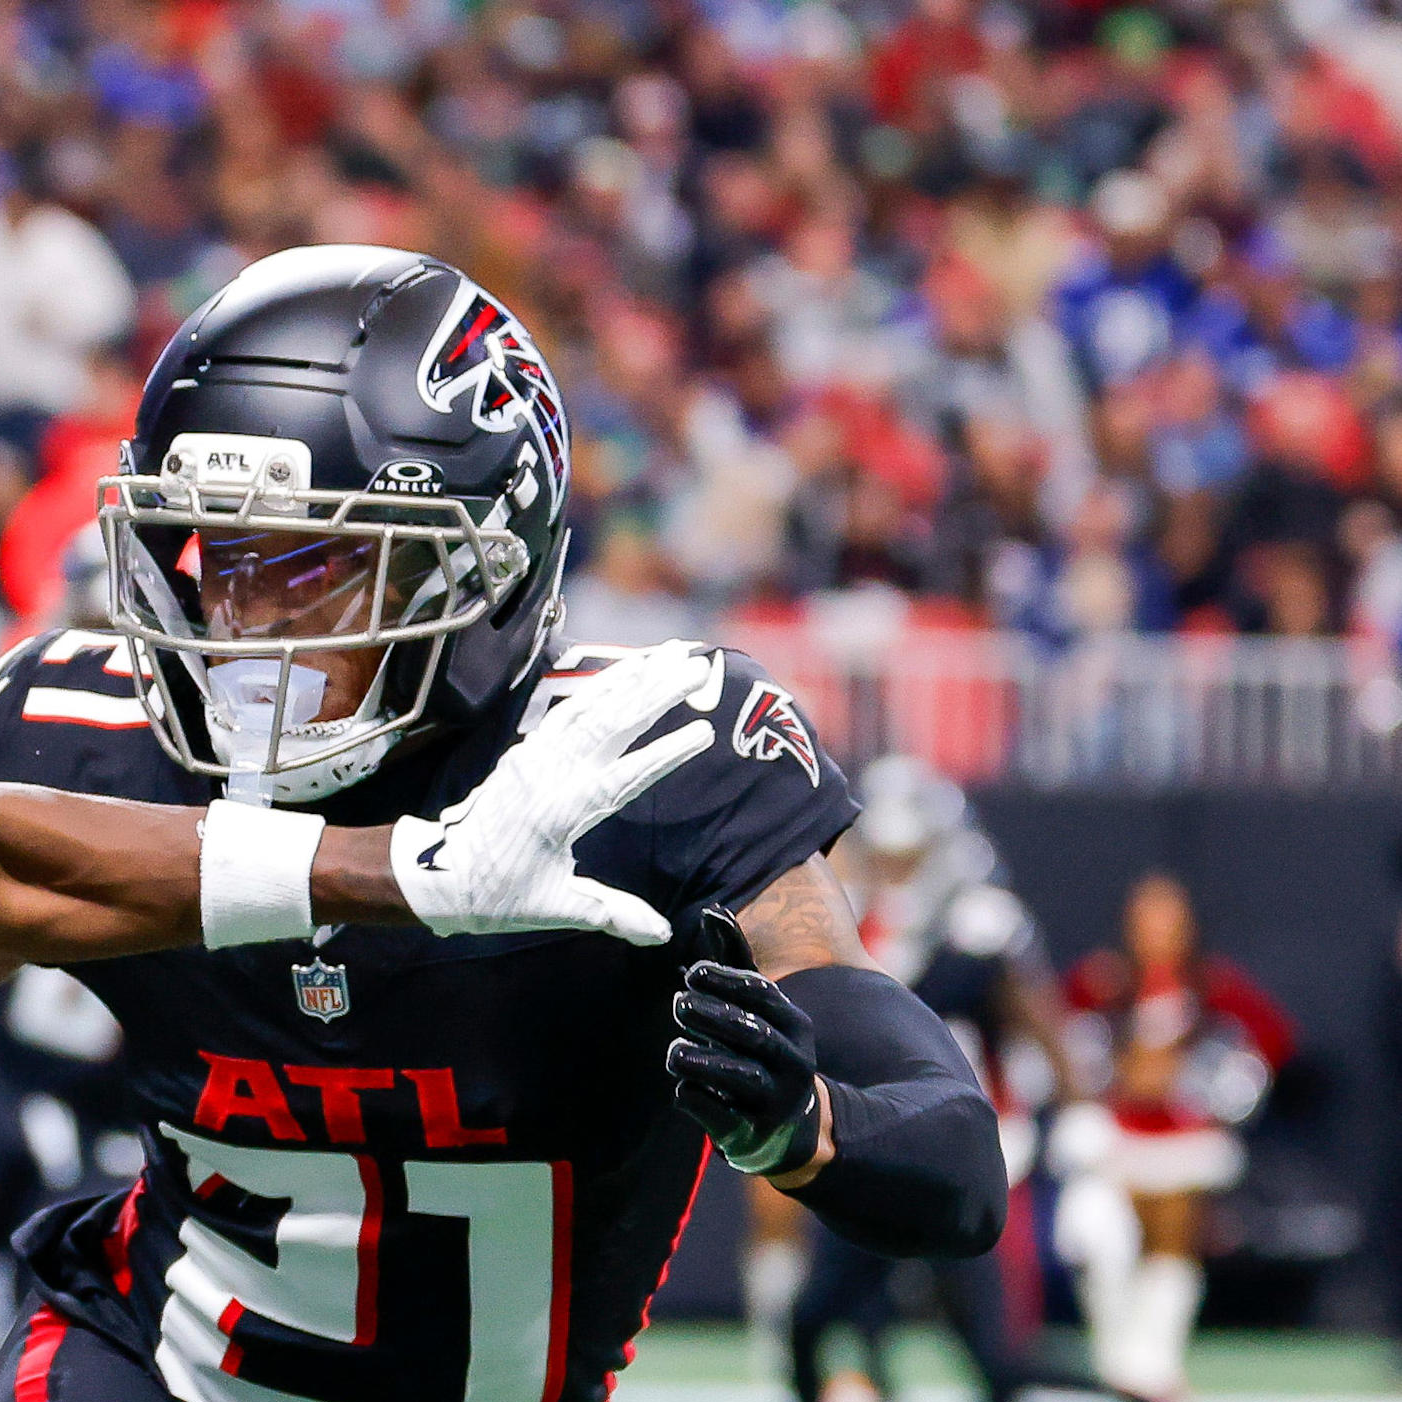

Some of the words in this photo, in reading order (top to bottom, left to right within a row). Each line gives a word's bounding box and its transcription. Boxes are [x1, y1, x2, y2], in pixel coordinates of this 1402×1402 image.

[207, 451, 251, 470] ATL
[375, 479, 443, 494] OAKLEY
[304, 988, 341, 1012] NFL
[195, 1051, 507, 1147] ATL
